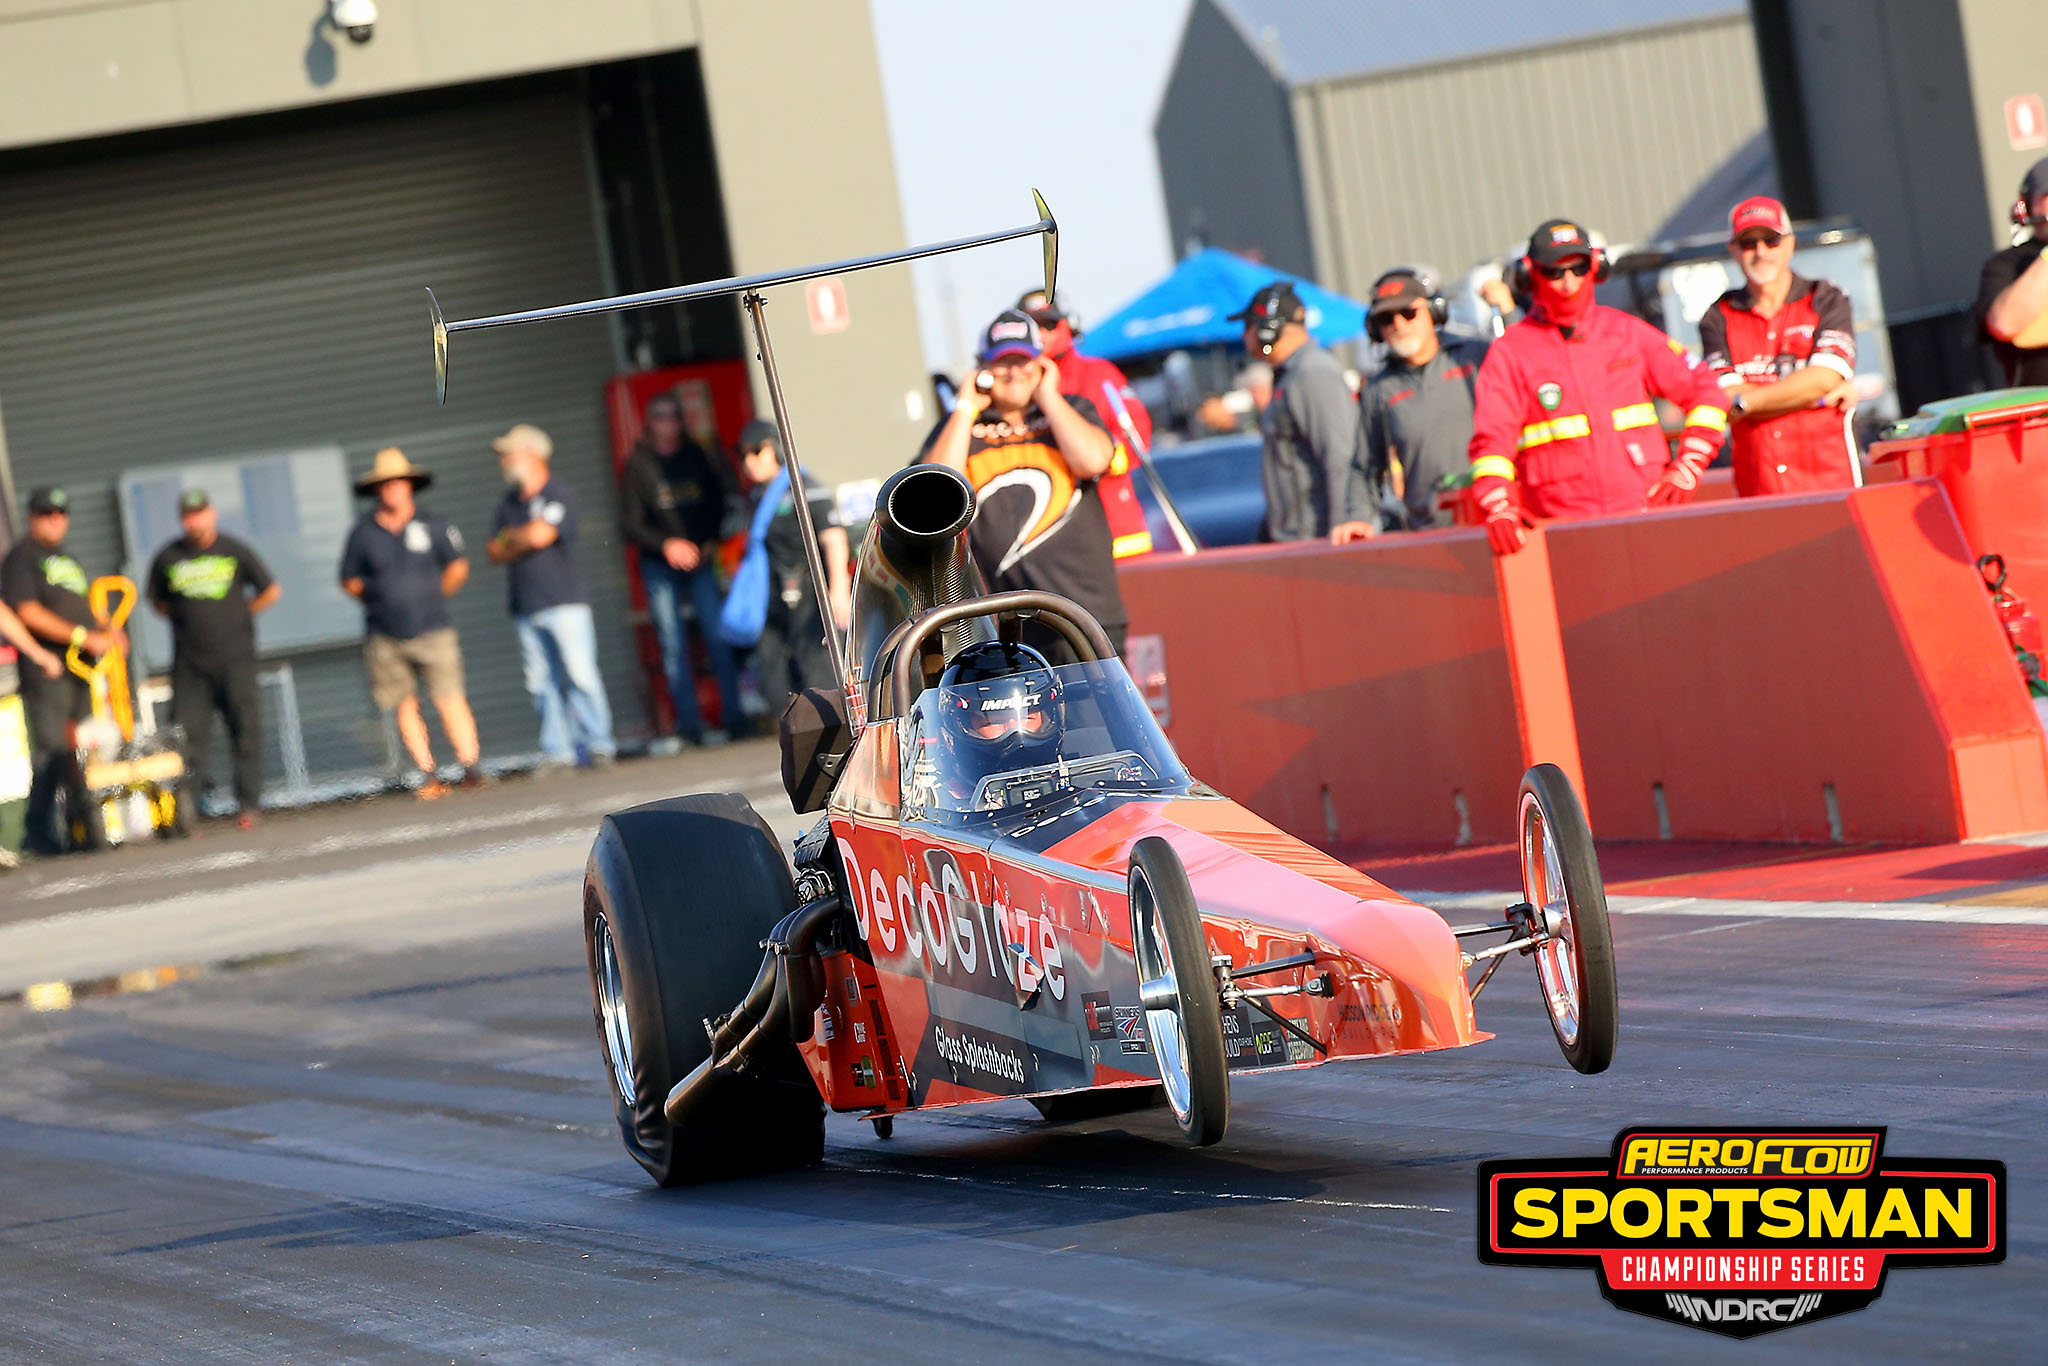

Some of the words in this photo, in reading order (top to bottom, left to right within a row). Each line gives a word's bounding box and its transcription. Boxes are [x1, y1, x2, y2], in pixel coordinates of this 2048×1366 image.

[981, 694, 1042, 711] IMPACT
[836, 837, 1065, 1001] DecoGlaze
[935, 1025, 963, 1064] Glass
[961, 1033, 1025, 1084] Splashbacks
